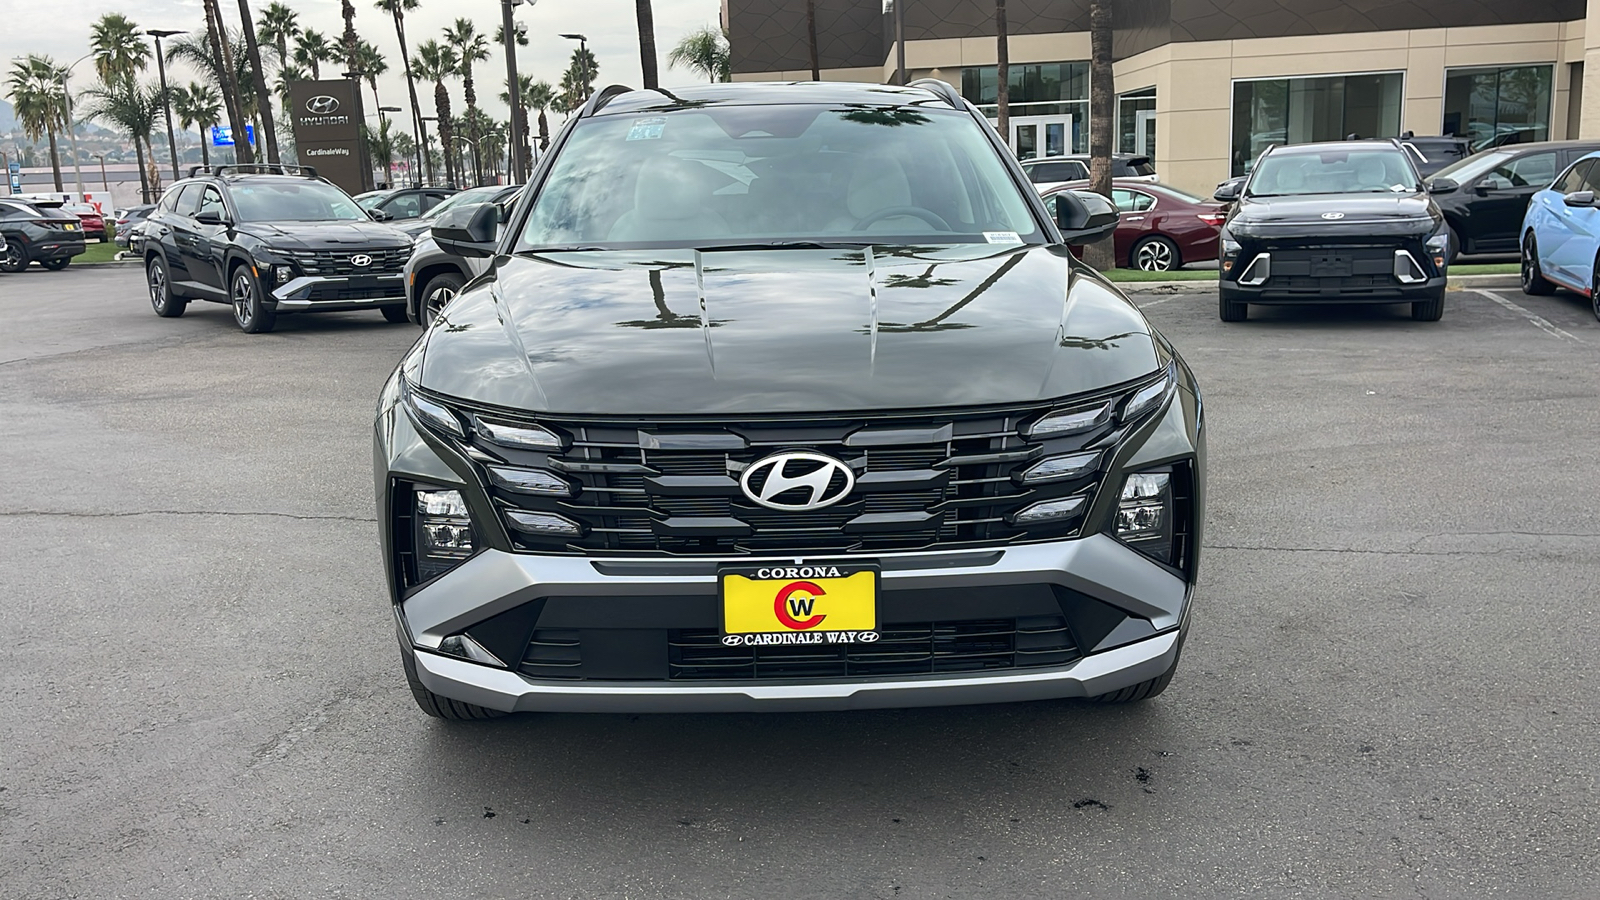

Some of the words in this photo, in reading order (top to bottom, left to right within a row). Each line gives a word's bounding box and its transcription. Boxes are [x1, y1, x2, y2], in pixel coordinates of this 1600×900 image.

[300, 115, 349, 126] HYUNDAI
[757, 566, 841, 579] CORONA
[744, 632, 823, 646] CARDINALE
[826, 631, 857, 643] WAY
